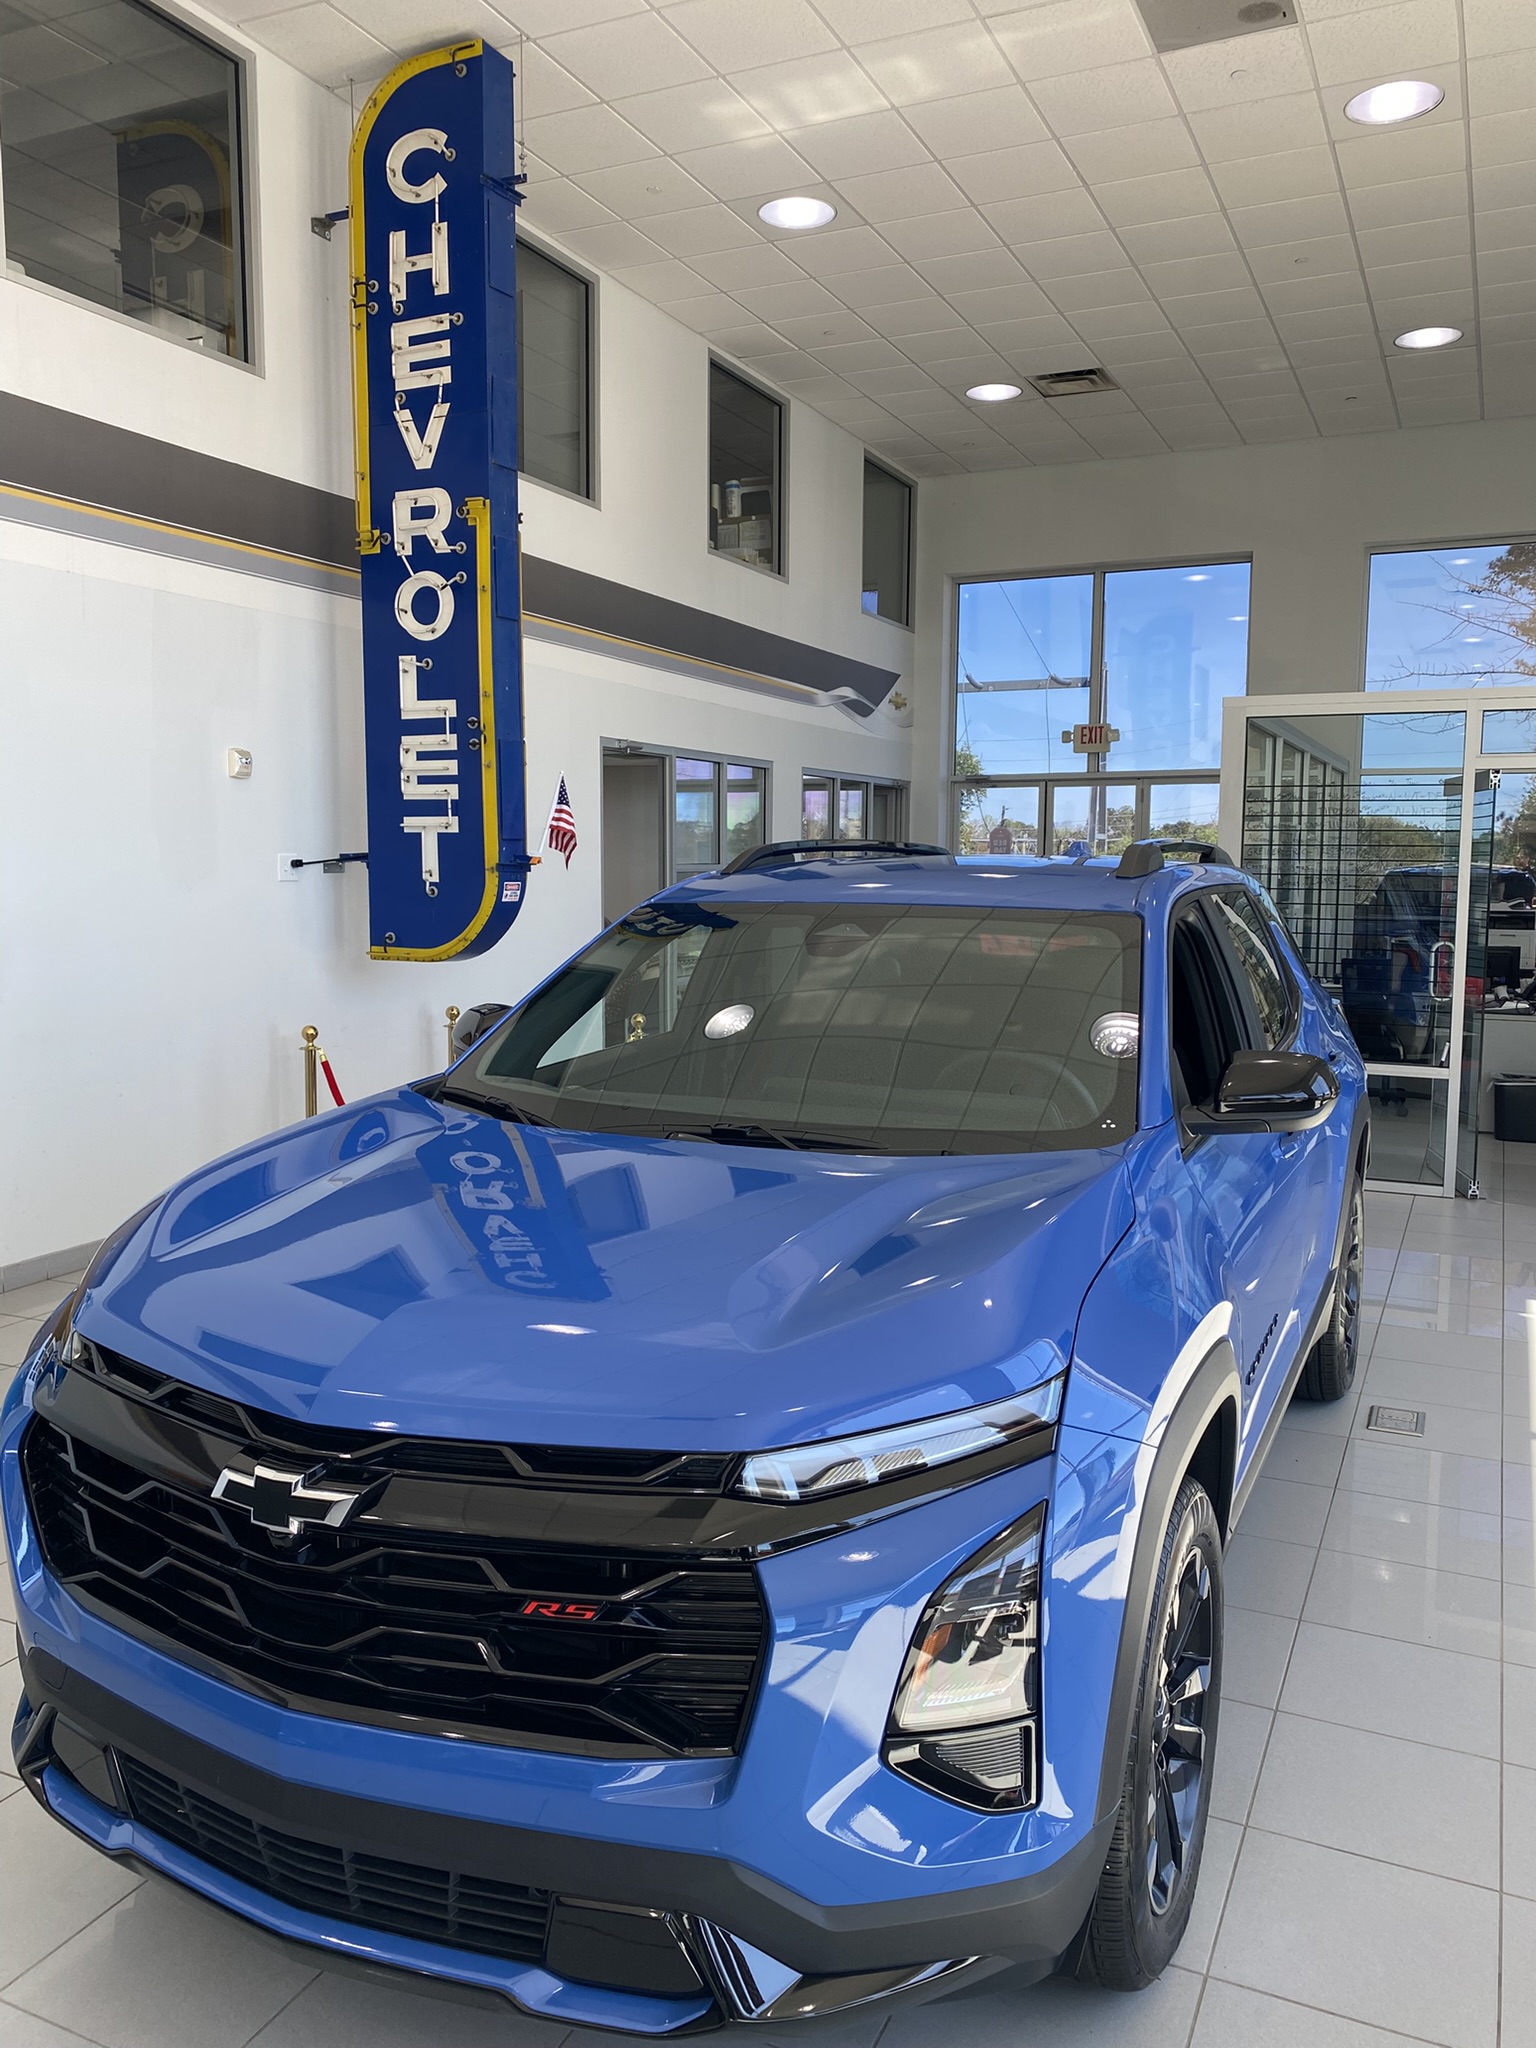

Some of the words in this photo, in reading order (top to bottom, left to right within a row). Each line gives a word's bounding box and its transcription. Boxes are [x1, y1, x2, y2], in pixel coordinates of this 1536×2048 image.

[385, 128, 459, 883] CHEVROLET
[1081, 726, 1104, 744] EXIT
[523, 1601, 600, 1620] RS
